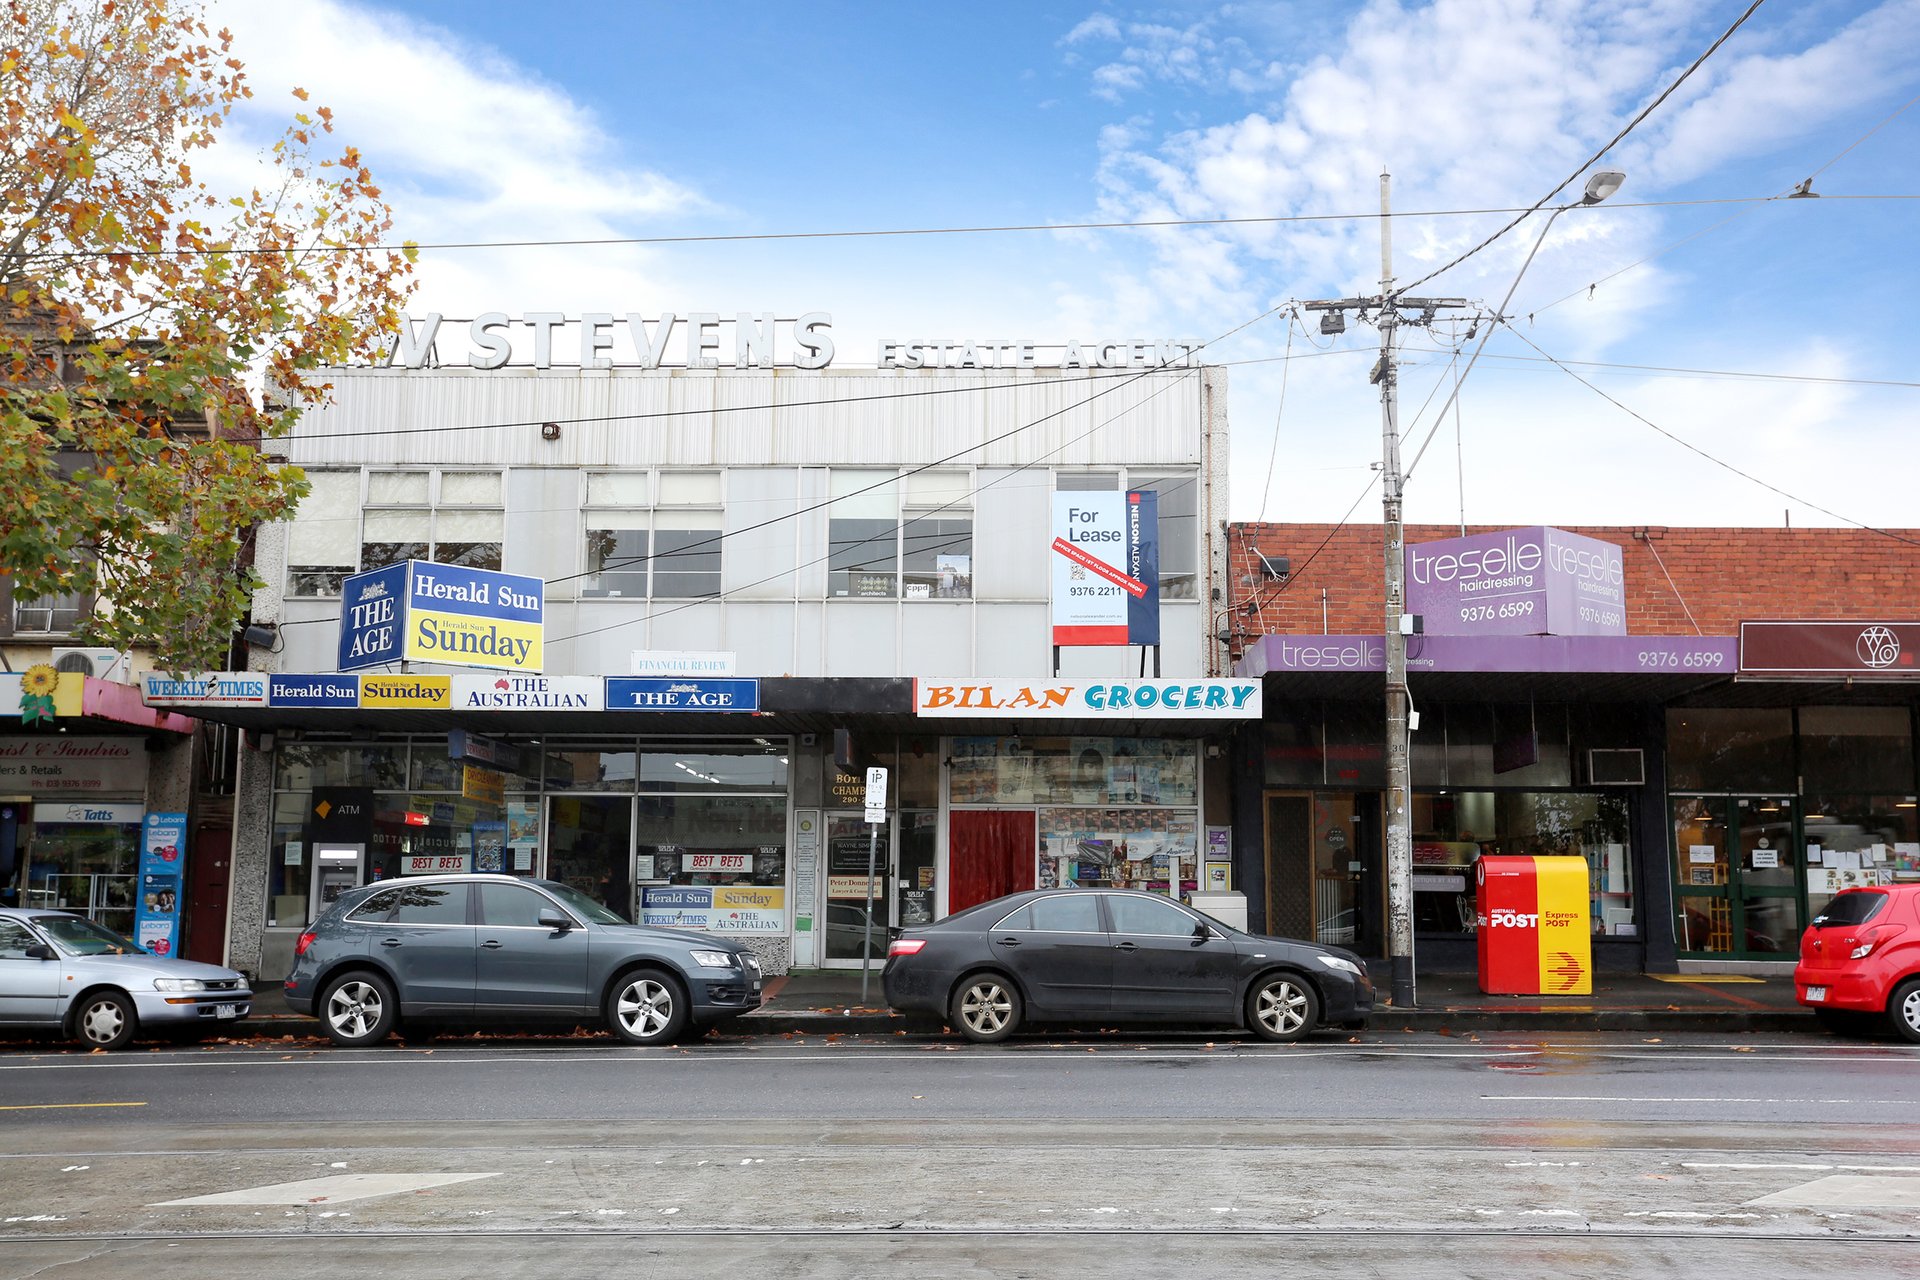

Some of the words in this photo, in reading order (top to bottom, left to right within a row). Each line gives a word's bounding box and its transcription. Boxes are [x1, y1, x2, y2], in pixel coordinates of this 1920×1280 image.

[468, 312, 835, 369] STEVENS
[878, 339, 1034, 368] ESTATE
[1060, 339, 1204, 368] AGENT
[1069, 508, 1099, 523] For
[1131, 505, 1140, 544] NELSON
[1069, 527, 1121, 542] Lease
[1055, 541, 1071, 553] OFFICE
[1071, 549, 1086, 561] SPACE
[1093, 562, 1109, 575] FLOOR
[1109, 571, 1127, 585] APPROX
[1132, 545, 1141, 584] ALEXAN
[1412, 536, 1542, 584] treselle
[1549, 534, 1623, 585] treselle
[907, 584, 928, 592] cppd
[1459, 573, 1533, 592] hairdressing
[1577, 578, 1619, 601] hairdressing
[415, 574, 489, 605] Herald
[498, 586, 540, 611] Sun
[1070, 587, 1095, 596] 9376
[1098, 587, 1121, 596] 2211
[350, 597, 395, 629] THE
[1460, 604, 1495, 623] 9376
[1498, 601, 1534, 619] 6599
[1579, 606, 1600, 624] 9376
[1602, 609, 1620, 627] 6599
[442, 620, 467, 630] Herald
[470, 622, 485, 631] Sun
[349, 626, 393, 658] AGE
[418, 618, 533, 665] Sunday
[1282, 640, 1385, 667] treselle
[1638, 652, 1678, 667] 9376
[1683, 652, 1723, 667] 6599
[639, 660, 688, 671] FINANCIAL
[691, 660, 726, 671] REVIEW
[147, 680, 208, 696] WEEKLY
[218, 680, 264, 697] TIMES
[272, 685, 322, 698] Herald
[325, 685, 355, 698] Sun
[364, 682, 447, 702] Sunday
[512, 678, 548, 693] THE
[467, 691, 588, 708] AUSTRALIAN
[630, 692, 678, 706] THE
[686, 692, 732, 706] AGE
[922, 685, 1075, 710] BILAN
[1084, 684, 1257, 711] GROCERY
[1392, 744, 1405, 752] 30
[19, 765, 28, 775] &
[31, 766, 62, 775] Retails
[62, 780, 80, 788] 9376
[872, 773, 883, 783] 1P
[832, 786, 866, 795] CHAMB
[84, 809, 113, 820] Tatts
[338, 805, 360, 815] ATM
[412, 857, 434, 869] BEST
[439, 857, 463, 869] BETS
[692, 856, 715, 866] BEST
[720, 856, 744, 867] BETS
[646, 894, 682, 903] Herald
[686, 894, 708, 903] Sun
[724, 892, 772, 906] Sunday
[644, 914, 677, 925] WEEKLY
[682, 914, 707, 925] TIMES
[740, 912, 758, 920] THE
[1491, 914, 1539, 927] POST
[1545, 911, 1578, 919] Express
[141, 922, 170, 930] Lebara
[715, 919, 779, 929] AUSTRALIAN
